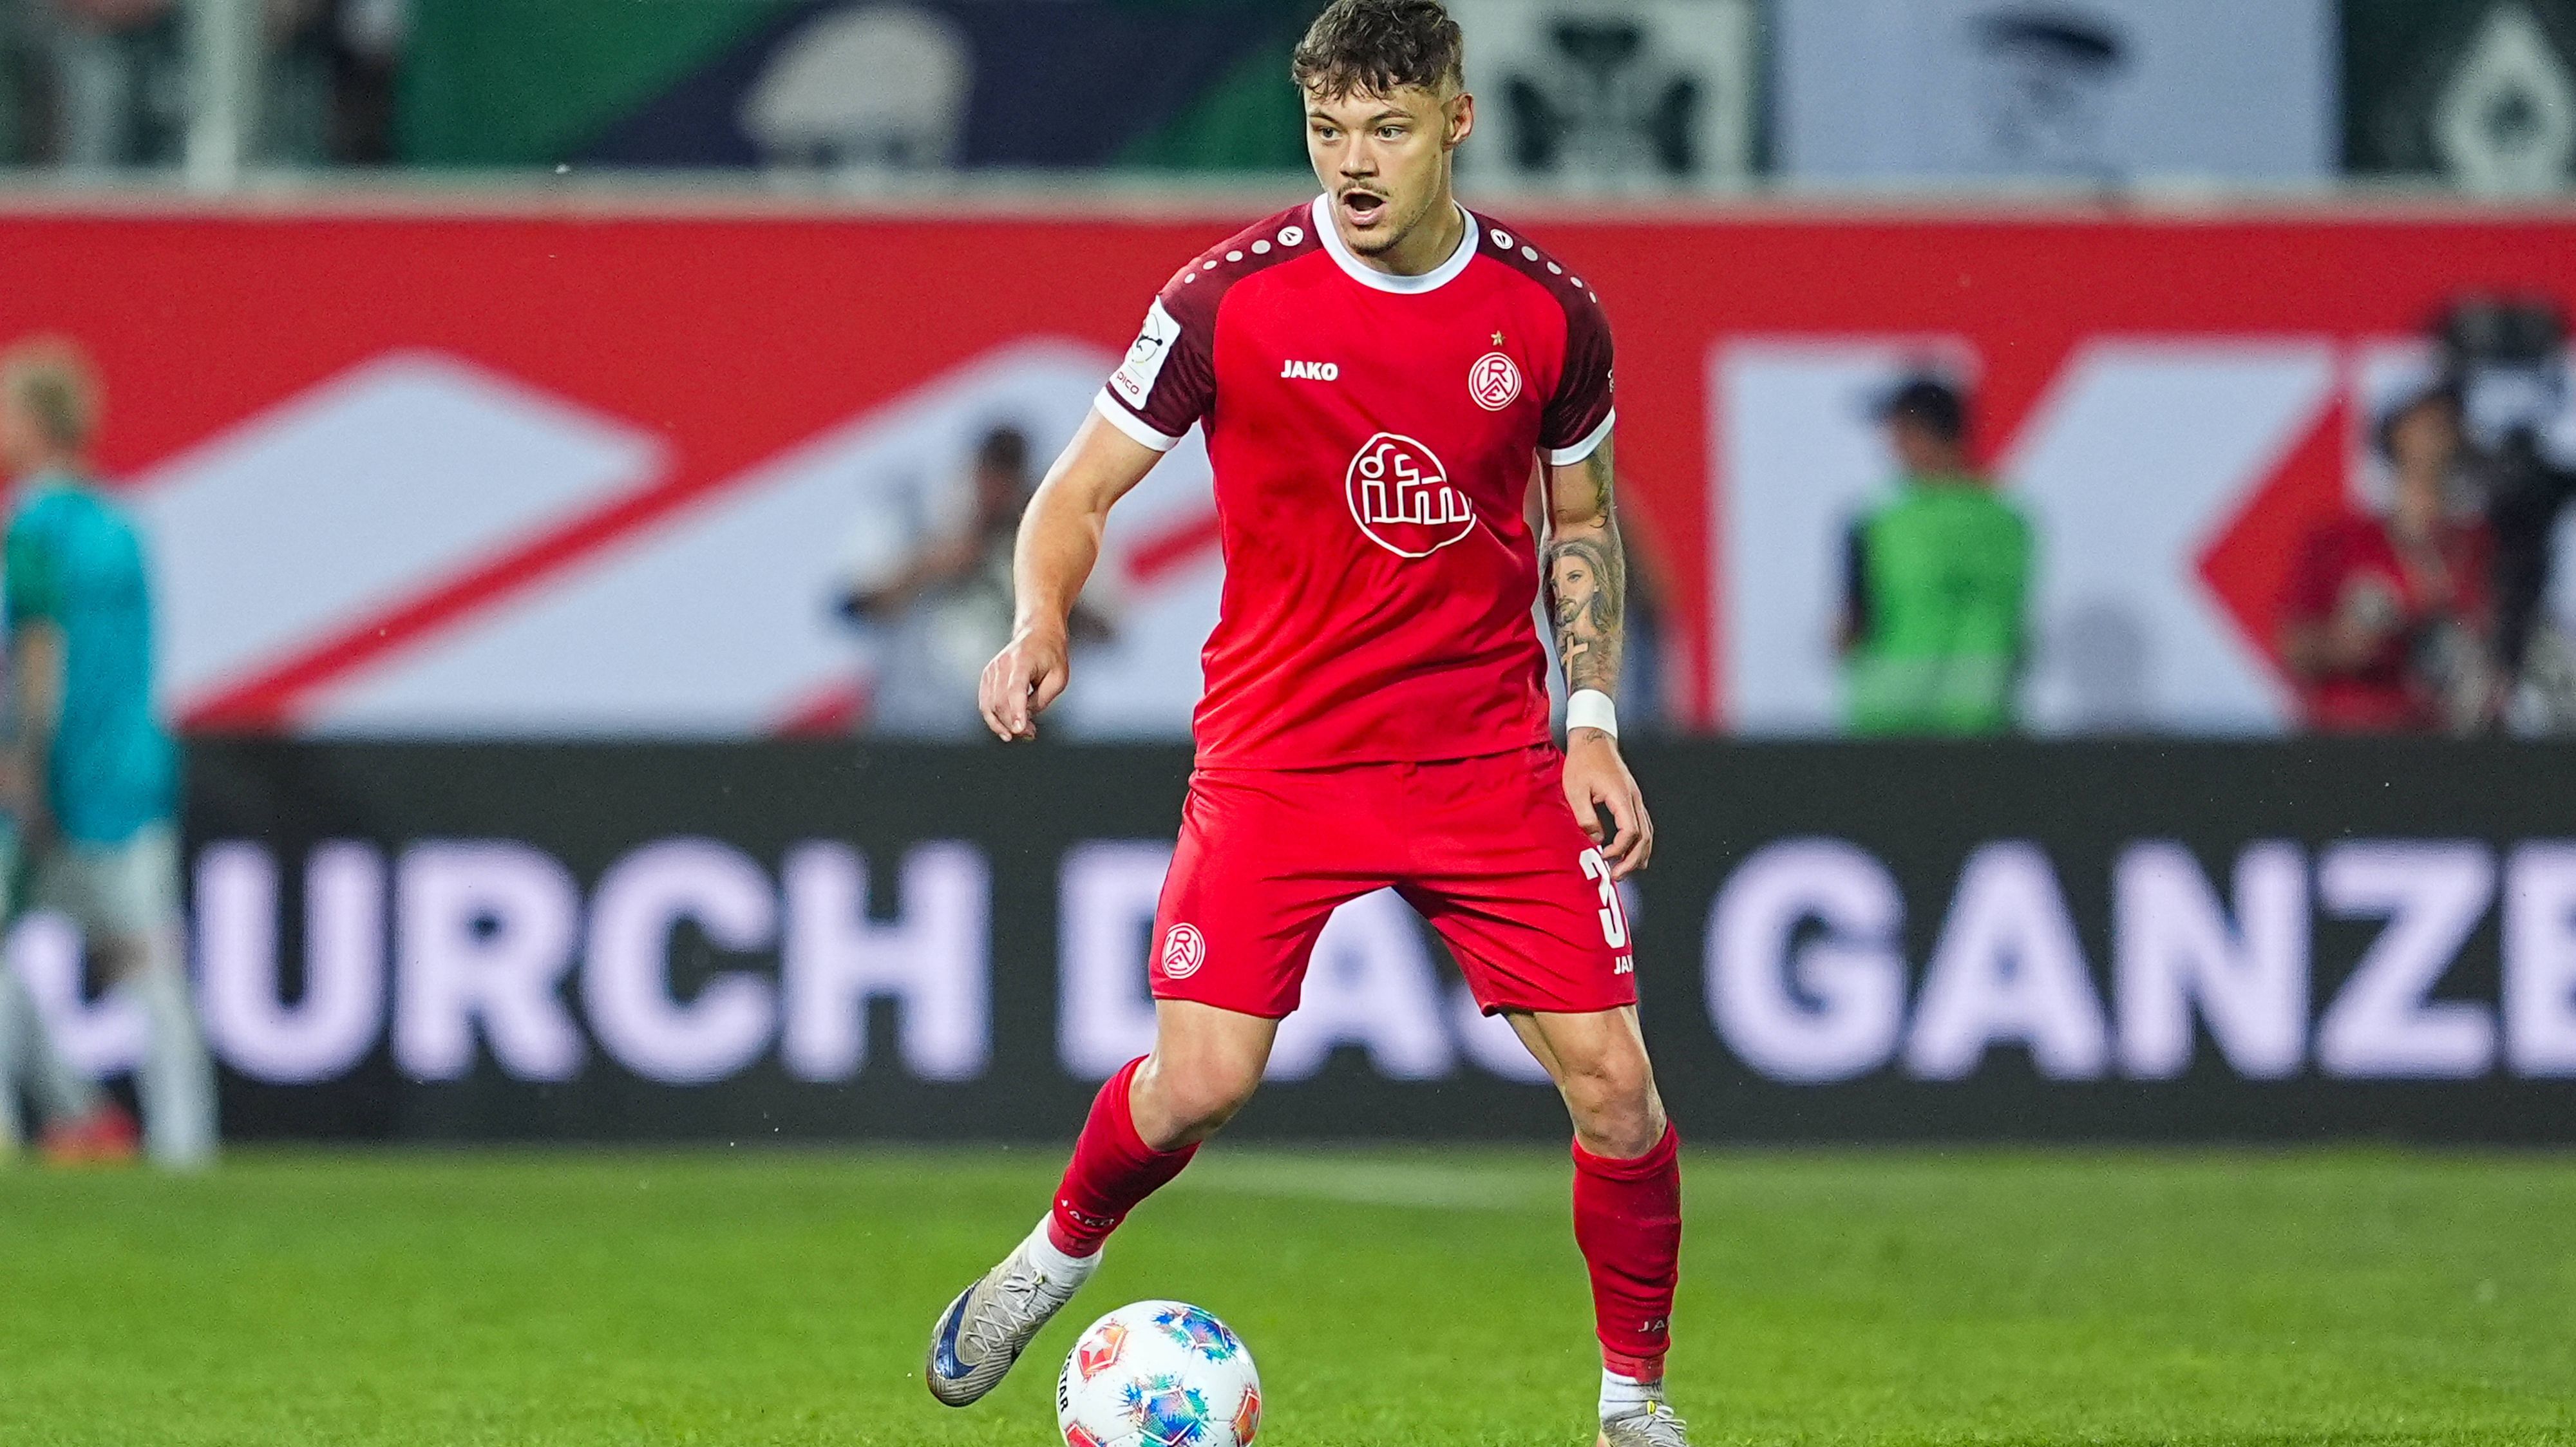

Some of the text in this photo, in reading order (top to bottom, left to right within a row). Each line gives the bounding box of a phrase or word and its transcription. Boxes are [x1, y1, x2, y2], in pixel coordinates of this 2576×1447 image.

[1280, 359, 1338, 381] JAKO
[1358, 442, 1472, 525] ifm
[1638, 1318, 1669, 1332] JA
